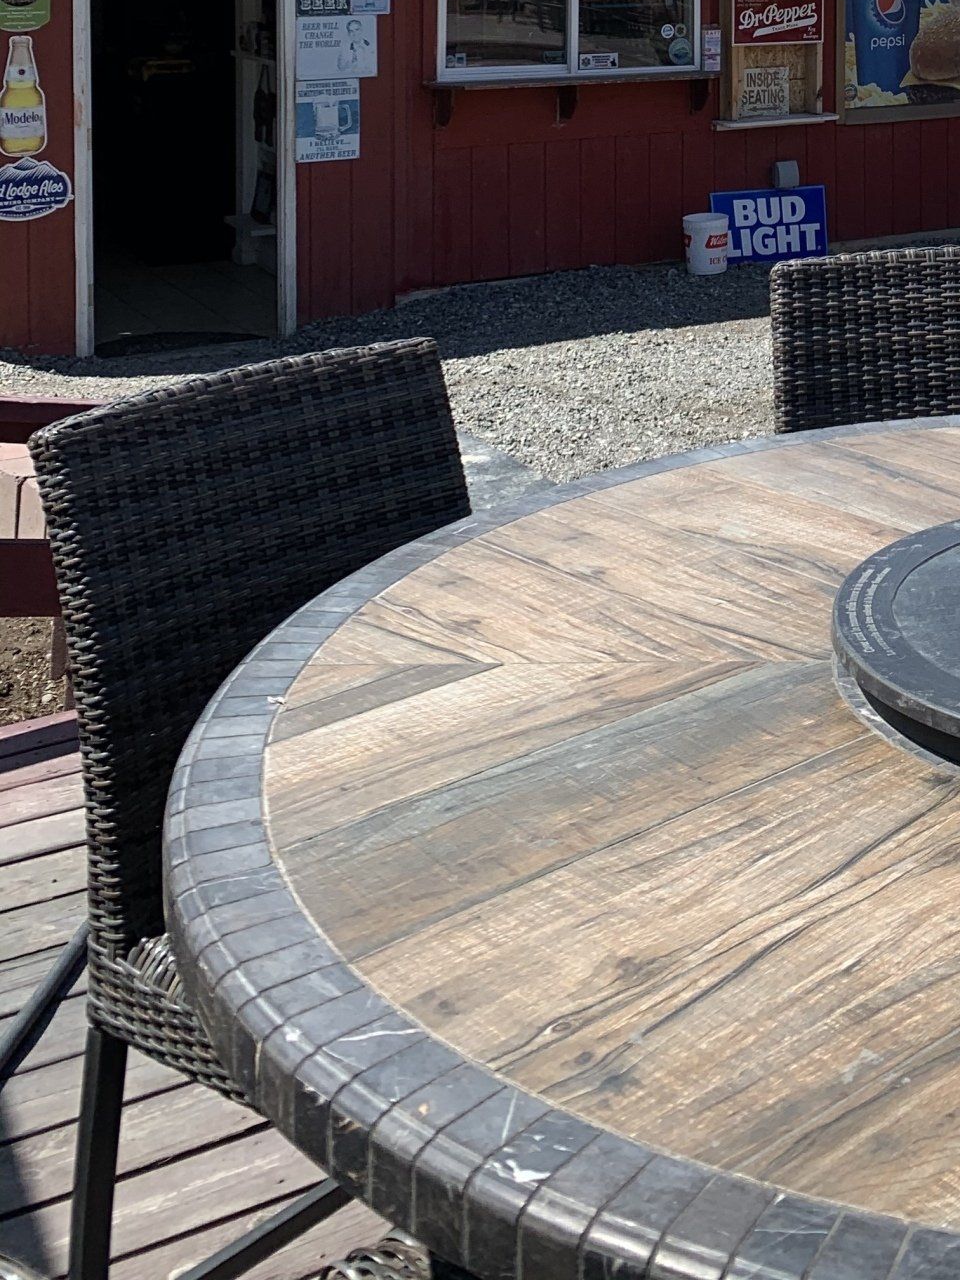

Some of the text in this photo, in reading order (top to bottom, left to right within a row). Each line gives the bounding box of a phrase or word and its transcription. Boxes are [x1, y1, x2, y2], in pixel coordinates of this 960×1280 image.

[301, 22, 321, 31] BEER
[304, 31, 334, 40] CHANGE
[870, 34, 905, 51] pepsi
[299, 40, 314, 49] THE
[746, 71, 780, 88] INSIDE
[741, 89, 785, 106] SEATING
[5, 111, 39, 125] Modelo
[337, 149, 357, 158] BEER
[6, 182, 39, 200] Lodge
[39, 179, 64, 197] Ales
[732, 195, 806, 228] BUD
[727, 222, 821, 258] LIGHT
